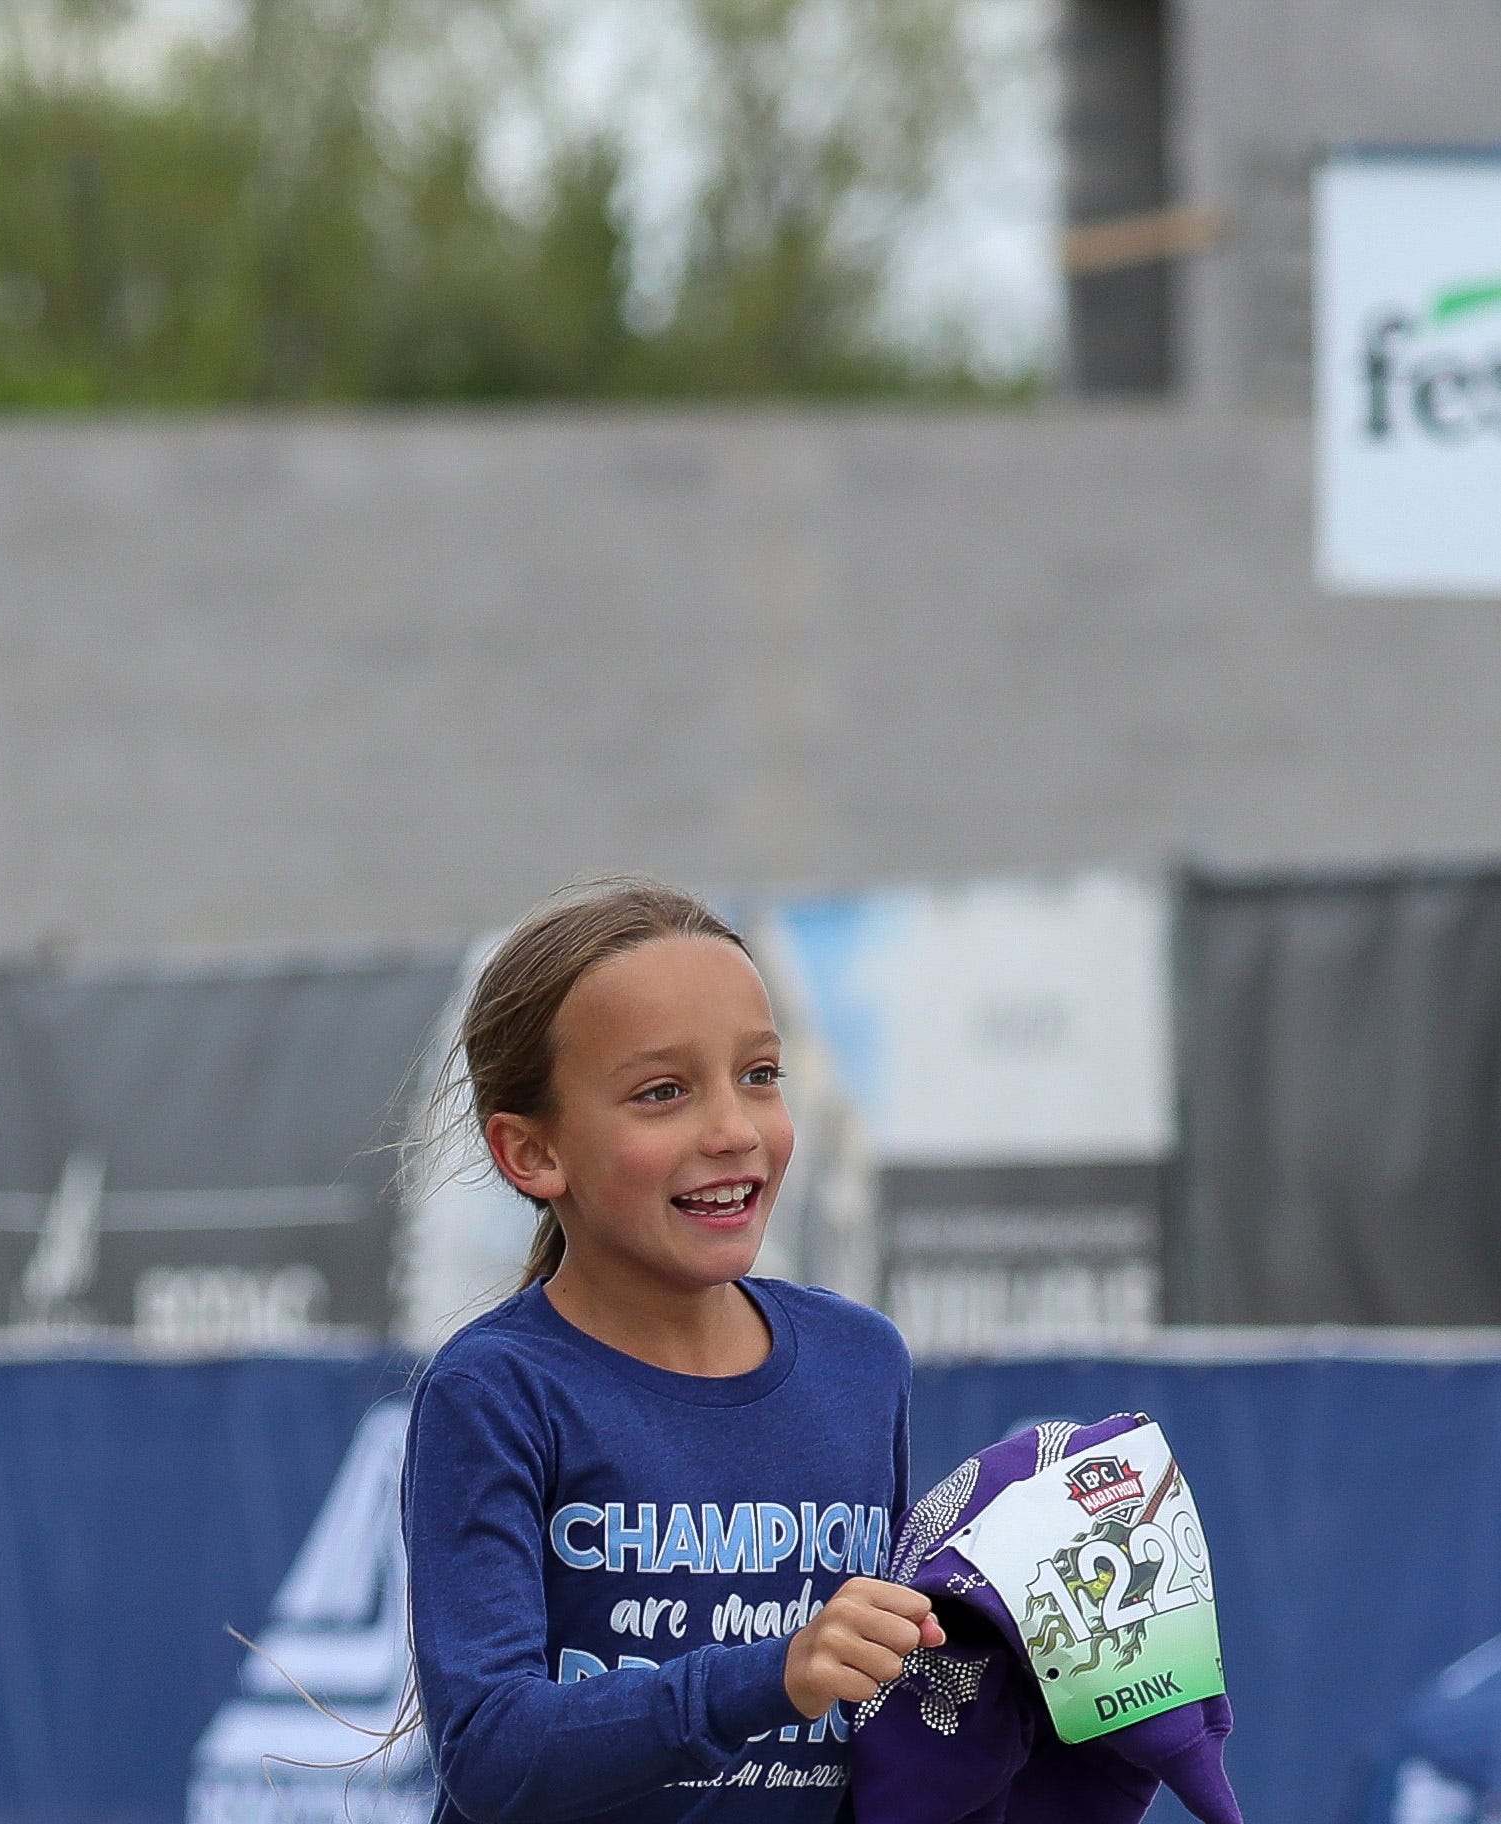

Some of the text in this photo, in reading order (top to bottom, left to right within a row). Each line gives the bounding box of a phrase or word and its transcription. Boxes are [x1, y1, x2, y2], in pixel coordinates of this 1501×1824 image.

[1080, 1478, 1142, 1512] MARATHON
[1025, 1510, 1214, 1643] 1229
[609, 1596, 688, 1639] are
[1094, 1671, 1183, 1722] DRINK
[725, 1761, 763, 1787] All
